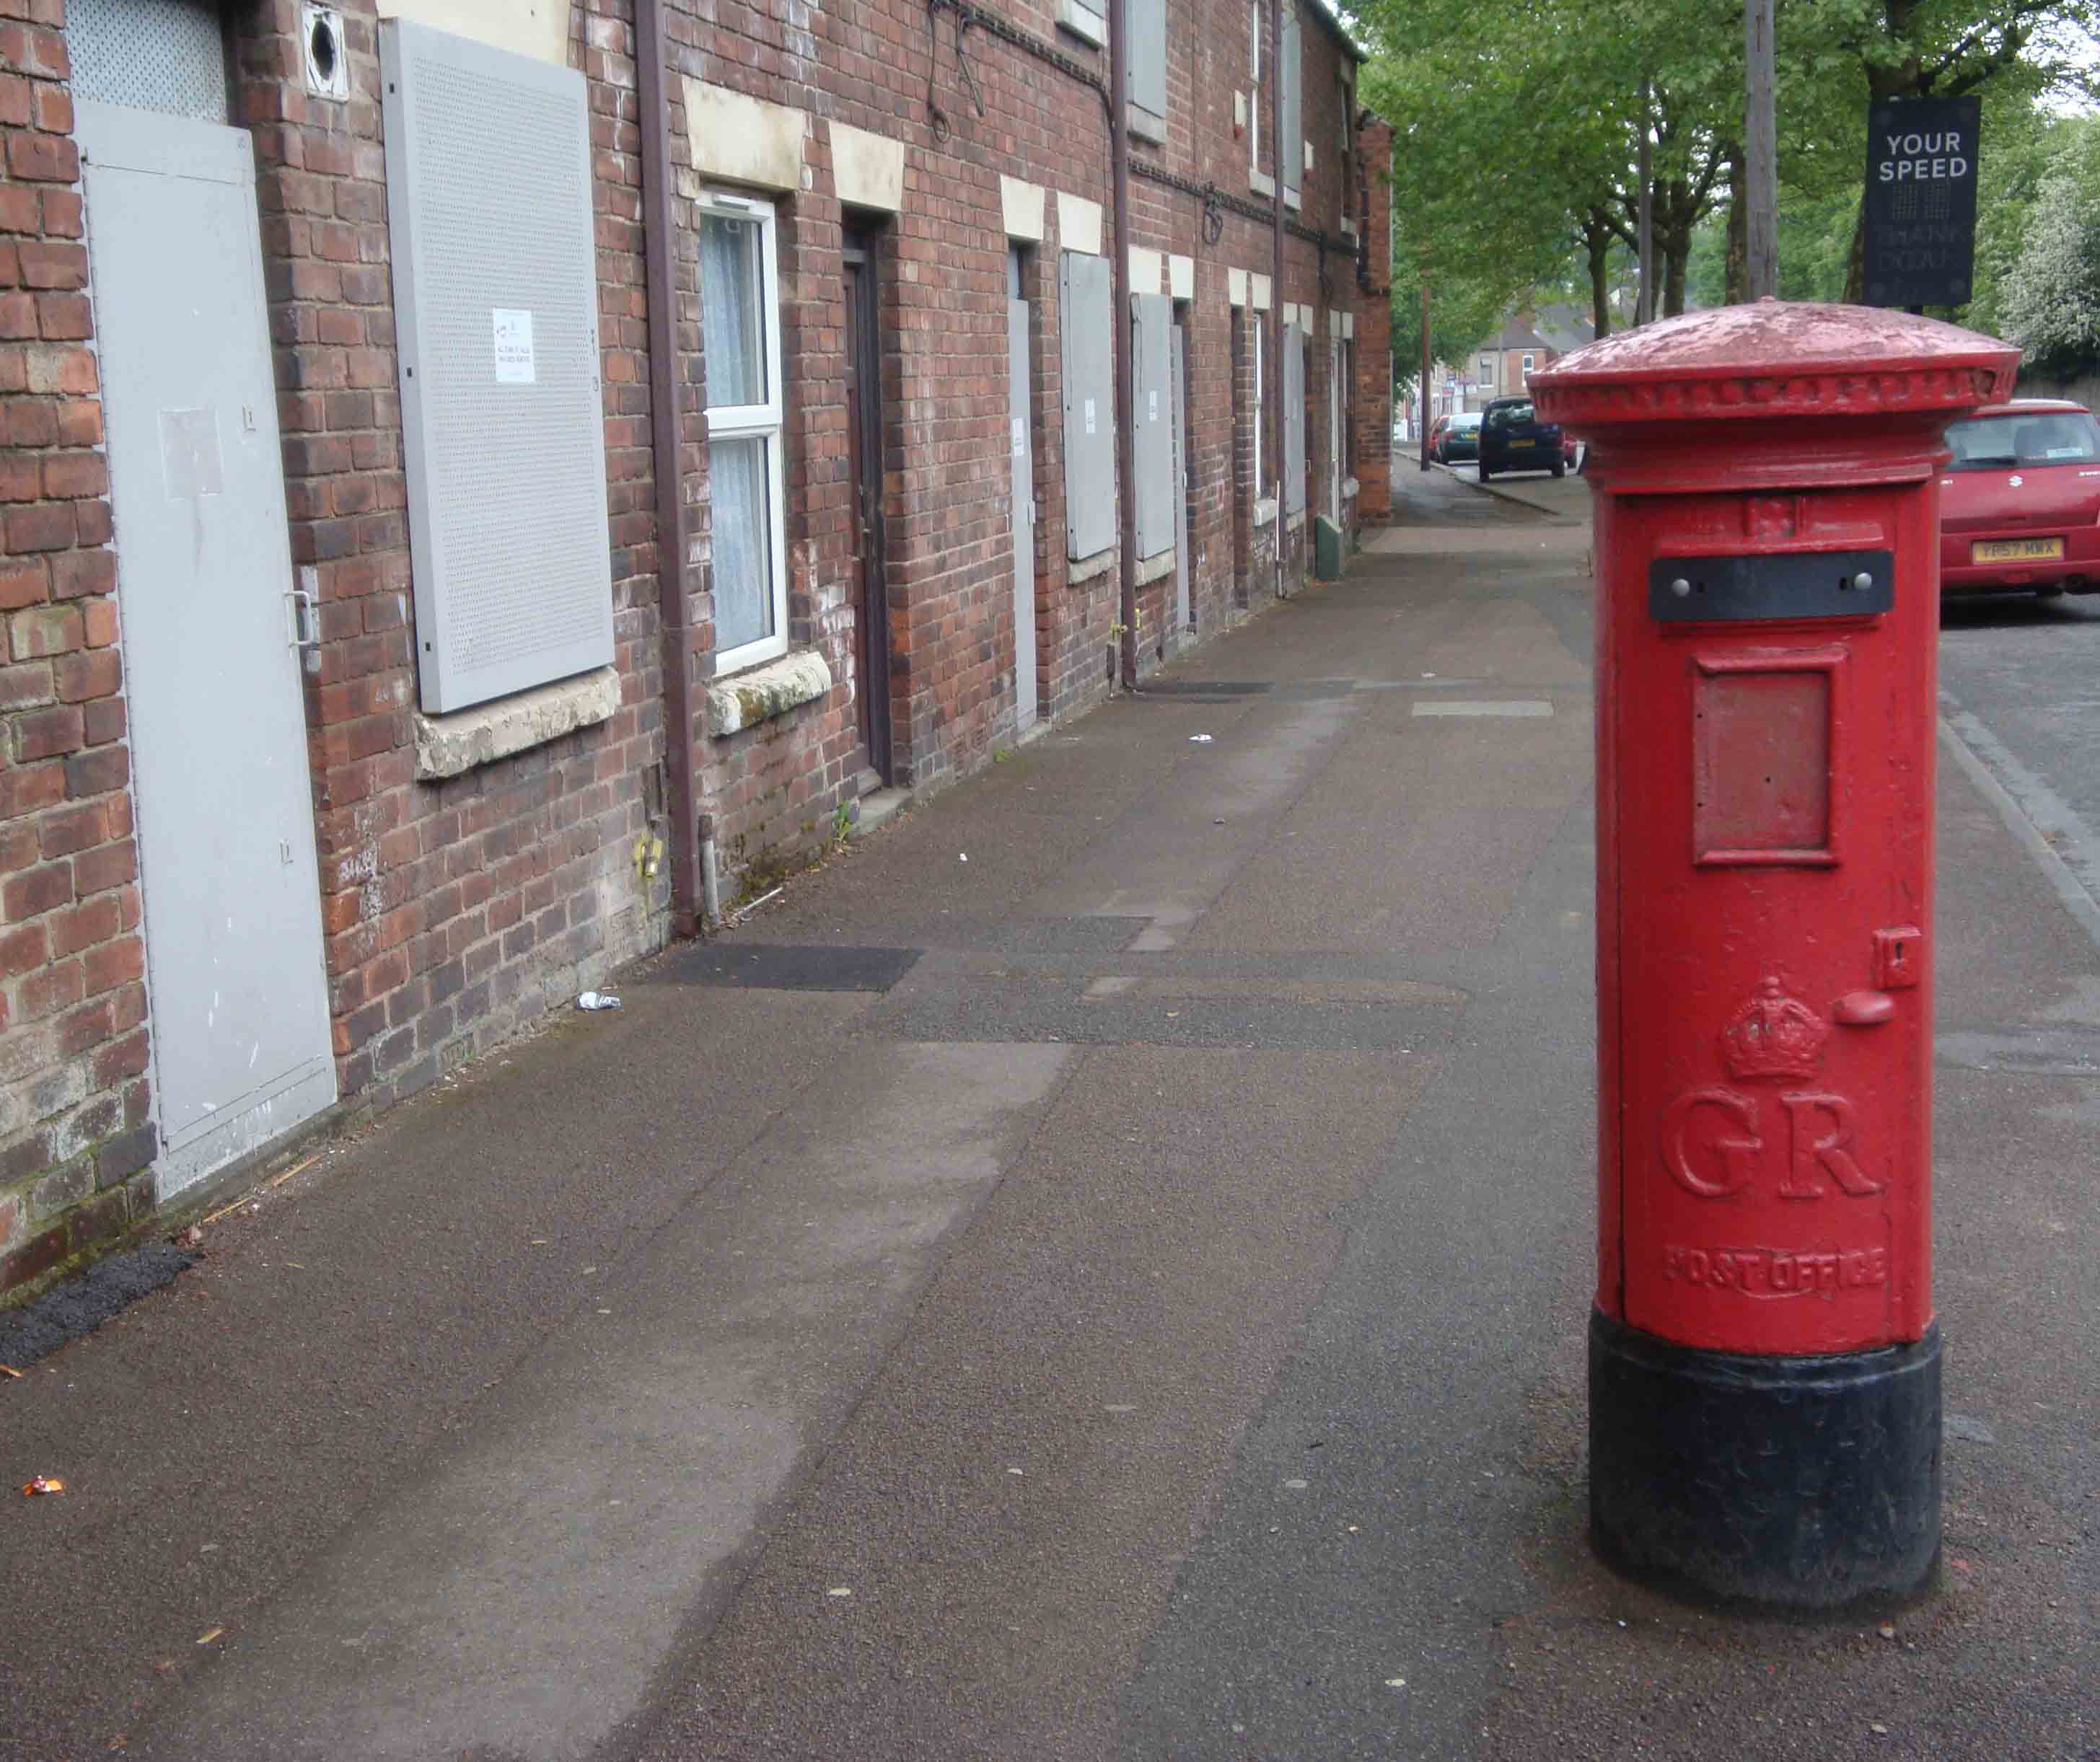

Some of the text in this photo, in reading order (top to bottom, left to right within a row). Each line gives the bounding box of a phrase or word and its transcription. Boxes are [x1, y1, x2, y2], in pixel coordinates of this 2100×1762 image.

[1886, 132, 1960, 155] YOUR
[1879, 157, 1967, 181] SPEED
[1661, 1088, 1881, 1199] GR
